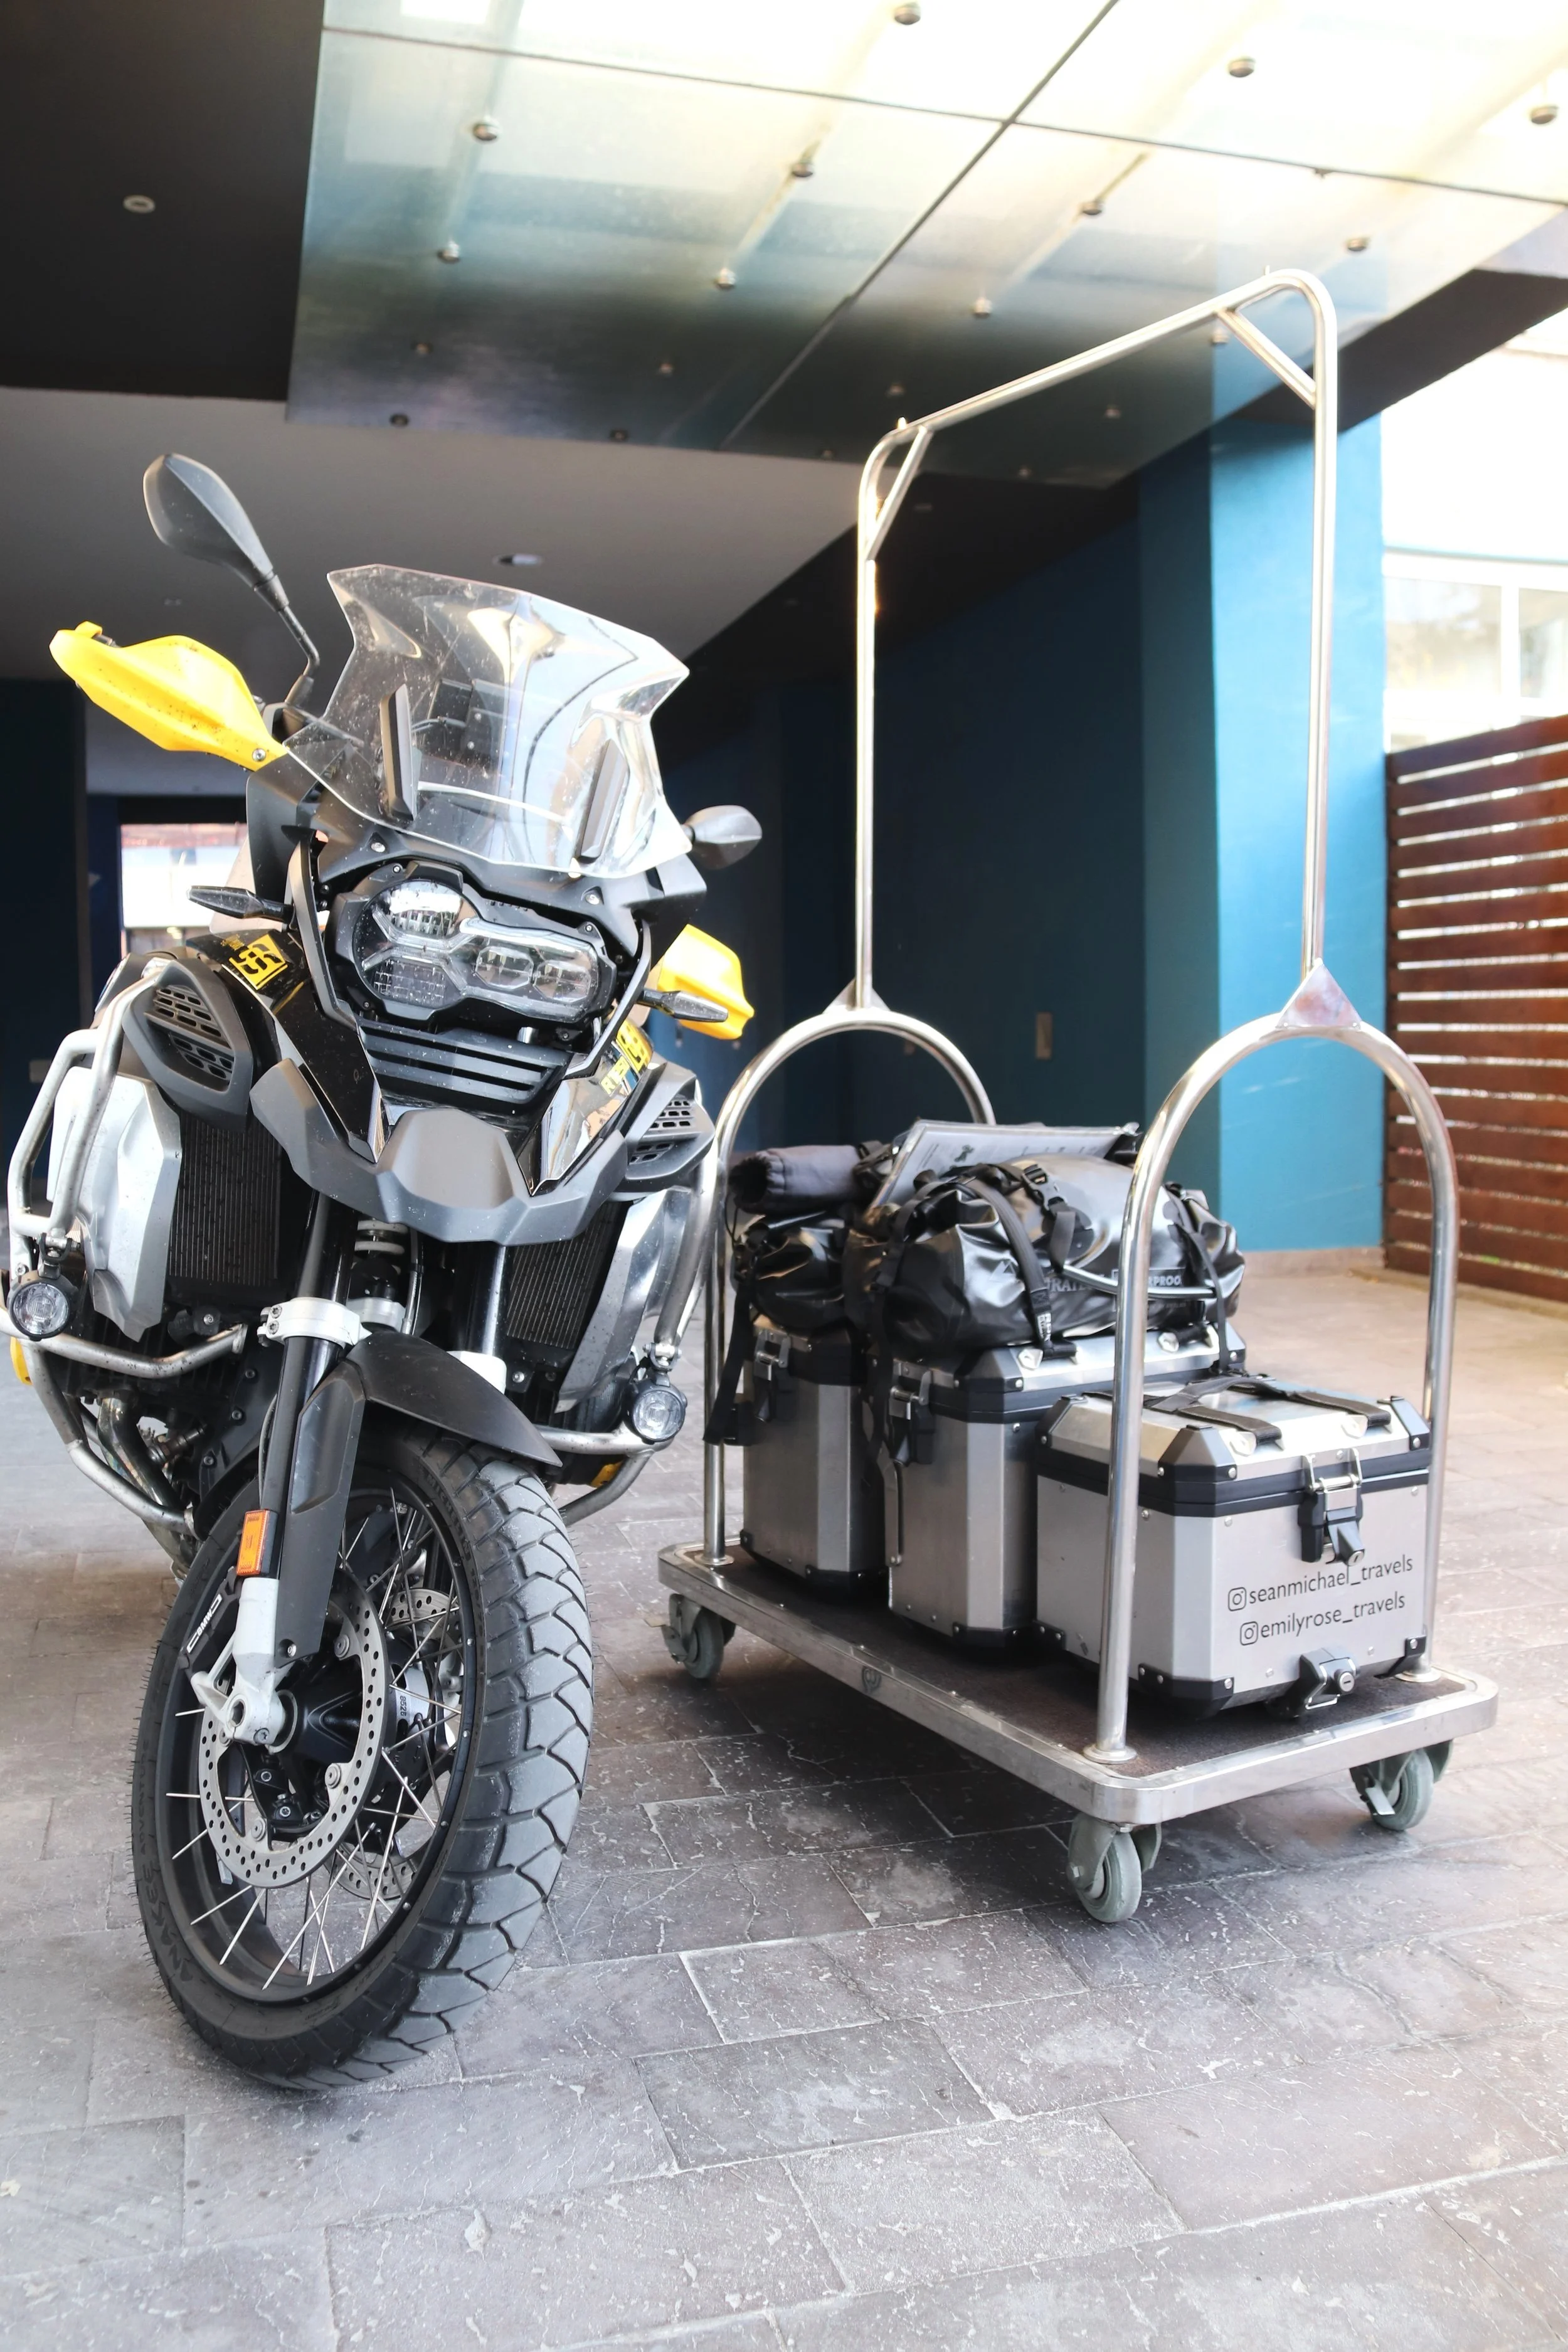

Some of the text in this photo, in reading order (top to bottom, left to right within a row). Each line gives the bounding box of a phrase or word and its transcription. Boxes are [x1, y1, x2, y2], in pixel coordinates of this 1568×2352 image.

[1249, 1554, 1413, 1604] seanmichael_travels
[196, 1608, 213, 1637] BMW
[1261, 1591, 1406, 1636] emilyrose_travels
[138, 1739, 150, 1855] ADVENTURE
[142, 1860, 193, 1982] ANAKEE
